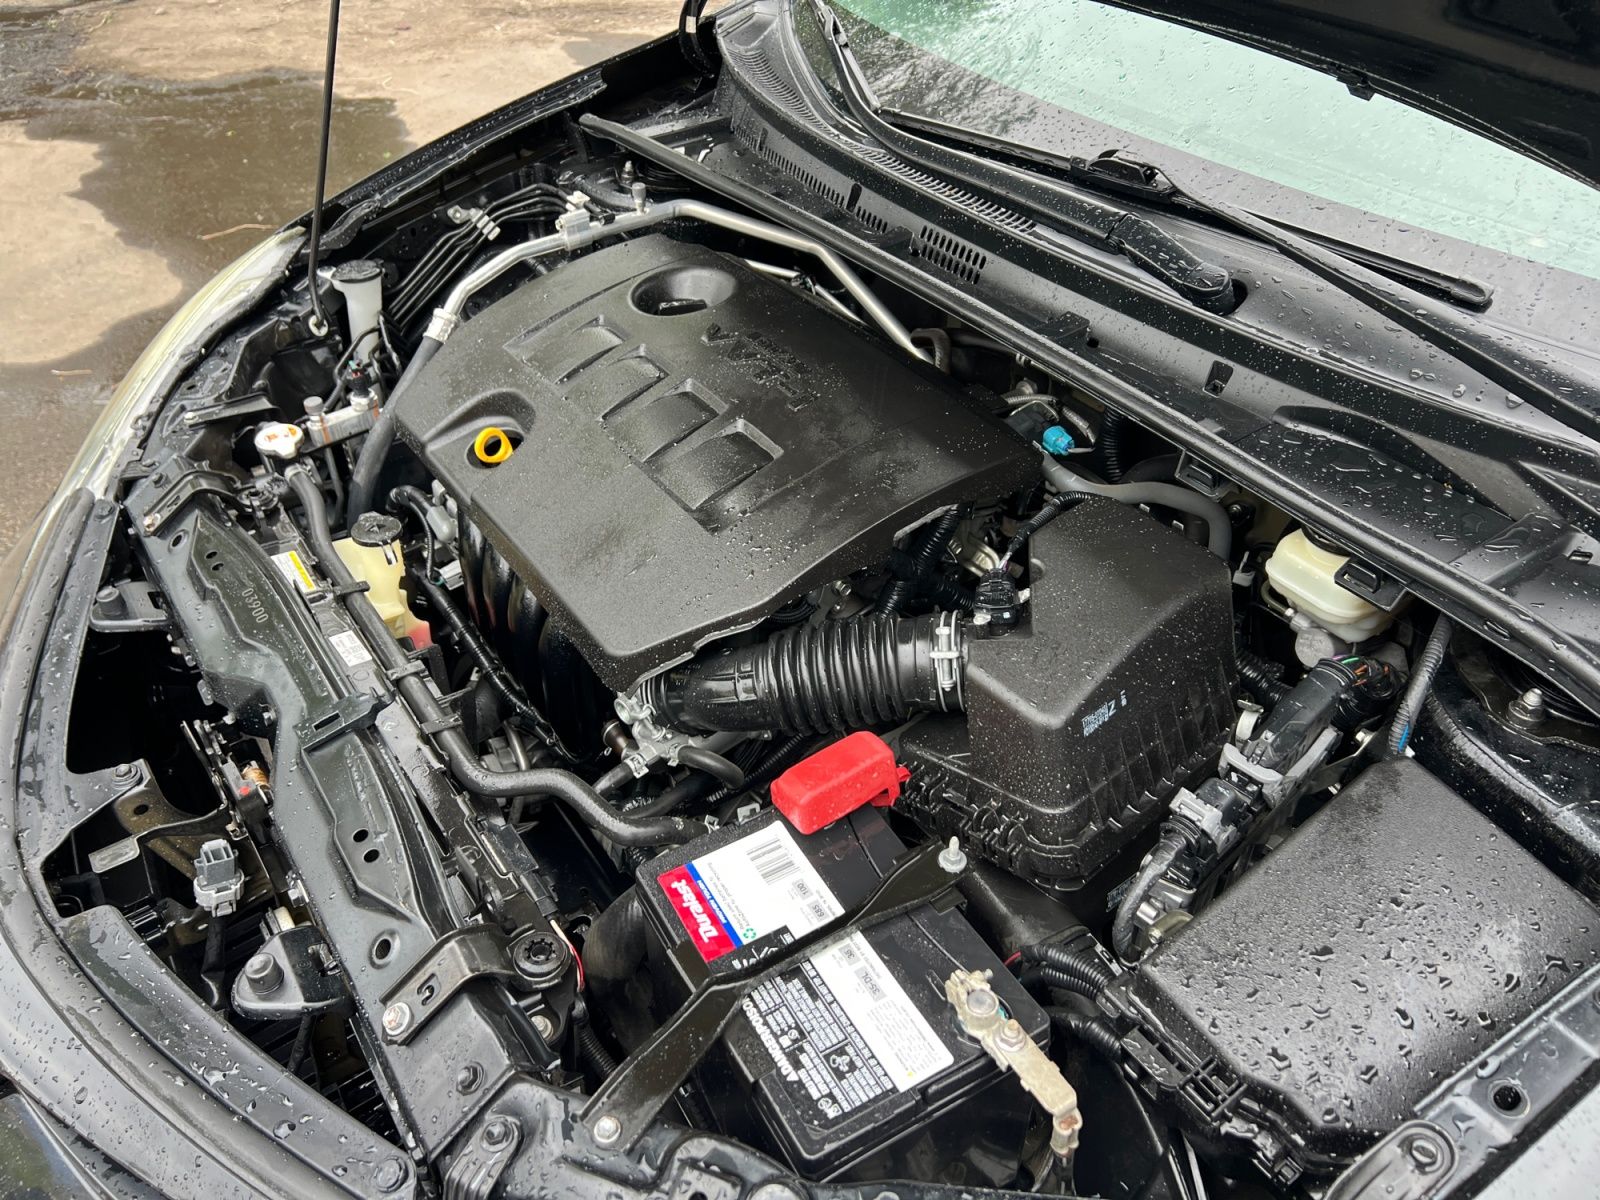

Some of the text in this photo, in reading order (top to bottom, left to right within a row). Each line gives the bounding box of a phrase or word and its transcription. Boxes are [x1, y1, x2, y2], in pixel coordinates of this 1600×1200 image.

[240, 586, 269, 624] 03900
[696, 878, 727, 924] PROVEN TOUGH
[796, 881, 809, 896] 100
[669, 879, 718, 942] Duralast
[859, 970, 881, 996] 35-DL
